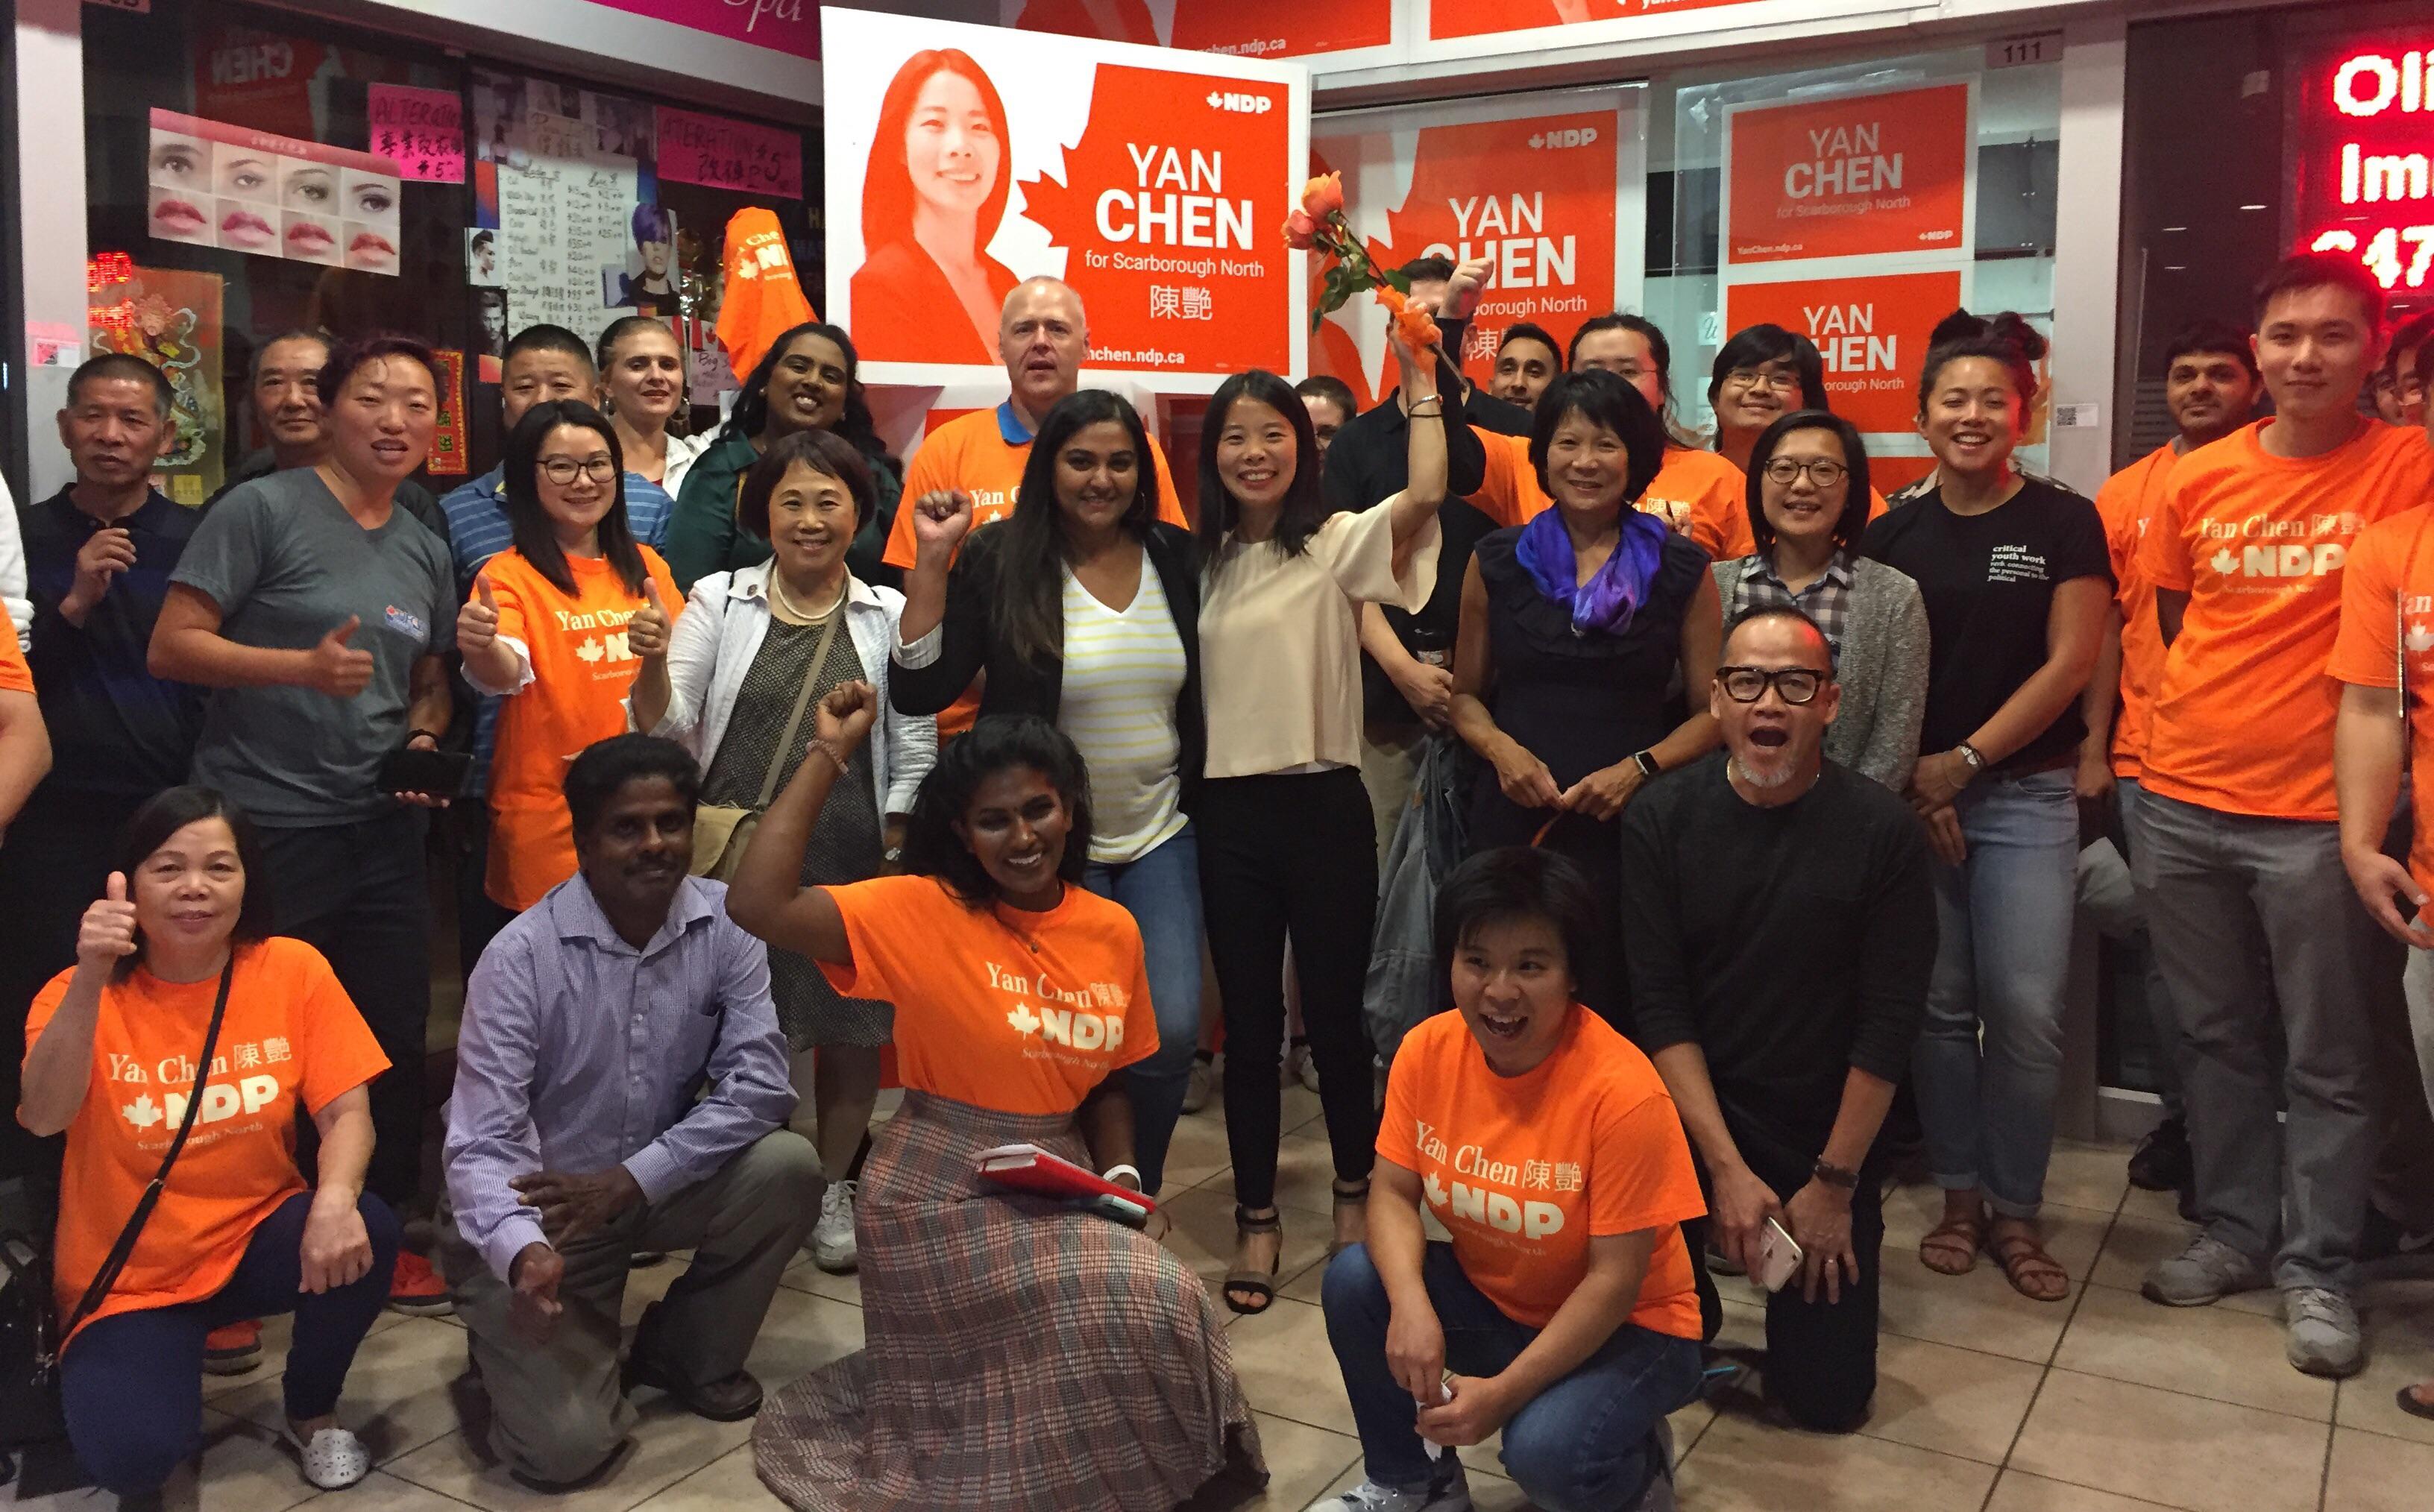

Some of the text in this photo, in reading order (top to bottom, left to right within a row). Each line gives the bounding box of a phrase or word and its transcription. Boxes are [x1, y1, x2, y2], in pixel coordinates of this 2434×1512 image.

[2004, 42, 2040, 63] 111
[1224, 91, 1272, 113] NDP
[1547, 127, 1597, 148] NDP
[1808, 122, 1880, 159] YAN
[1127, 142, 1221, 194] YAN
[1784, 152, 1902, 199] CHEN
[1096, 189, 1253, 251] CHEN
[1448, 192, 1543, 238] YAN
[1776, 195, 1911, 219] for Scarborough North
[1928, 230, 1954, 241] NDP
[1085, 250, 1264, 278] for Scarborough North
[1541, 294, 1588, 313] North
[1803, 303, 1873, 336] YAN
[1812, 335, 1897, 373] HEN
[1869, 377, 1905, 391] North
[969, 488, 1004, 508] Yan
[2201, 517, 2238, 538] Yan
[2242, 513, 2305, 538] Chen
[1992, 552, 2046, 564] youth work
[2243, 543, 2345, 578] NDP
[555, 611, 596, 631] Yan
[986, 961, 1029, 995] Yan
[1040, 1007, 1125, 1052] NDP
[157, 1054, 227, 1085] Chn
[164, 1074, 280, 1130] NDP
[1416, 1119, 1448, 1165] Yan
[1454, 1144, 1518, 1186] Chen
[1451, 1181, 1565, 1241] NDP
